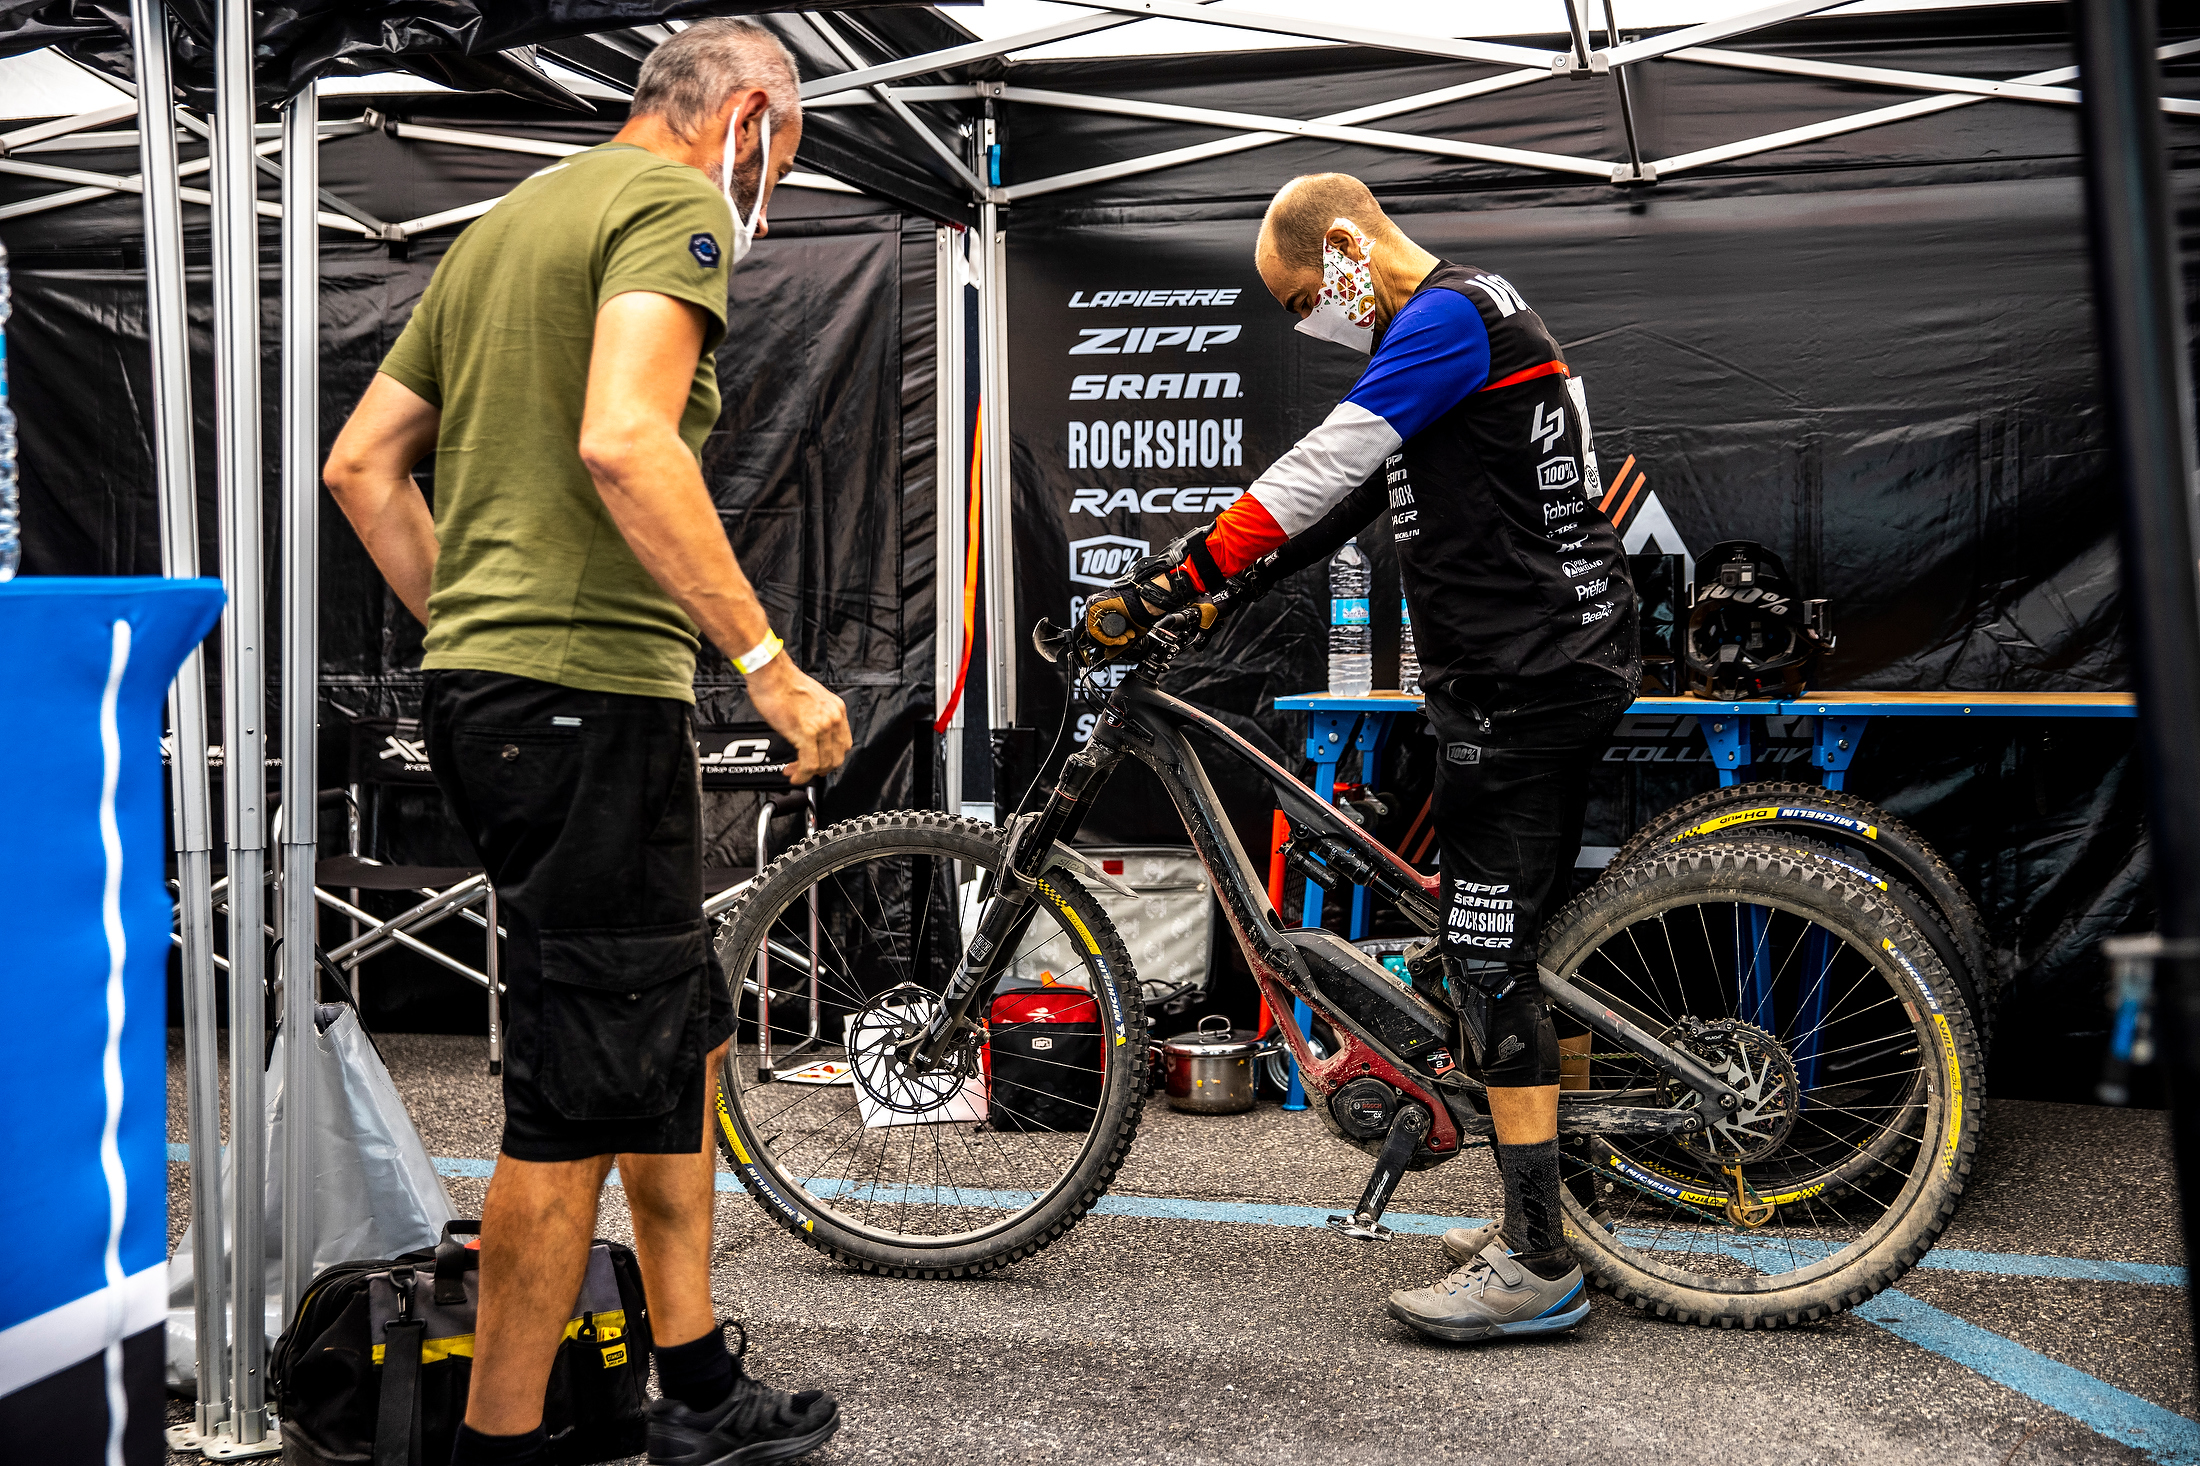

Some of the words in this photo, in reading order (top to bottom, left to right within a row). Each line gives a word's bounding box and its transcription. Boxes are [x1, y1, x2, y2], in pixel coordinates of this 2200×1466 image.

[1068, 288, 1242, 308] LAPIERRE
[1068, 324, 1242, 355] ZIPP
[1068, 418, 1243, 469] ROCKSHOX
[1543, 462, 1574, 484] 100%
[1068, 487, 1247, 517] RACER
[1543, 496, 1584, 526] fabric
[1080, 548, 1140, 575] 100%
[1697, 582, 1791, 615] 100%
[1450, 746, 1476, 761] 100%
[1782, 809, 1854, 827] MICHELIN
[1453, 878, 1510, 895] ZIPP
[1453, 892, 1513, 910] SRAM
[1448, 907, 1514, 933] ROCKSHOX
[1448, 930, 1513, 949] RACER
[1096, 958, 1121, 1022] MICHELIN
[1898, 956, 1938, 1011] MICHELIN
[1938, 1021, 1955, 1057] WILD
[1949, 1057, 1960, 1108] ENDURO
[747, 1166, 796, 1217] MICHELIN
[1626, 1168, 1677, 1195] MICHELIN
